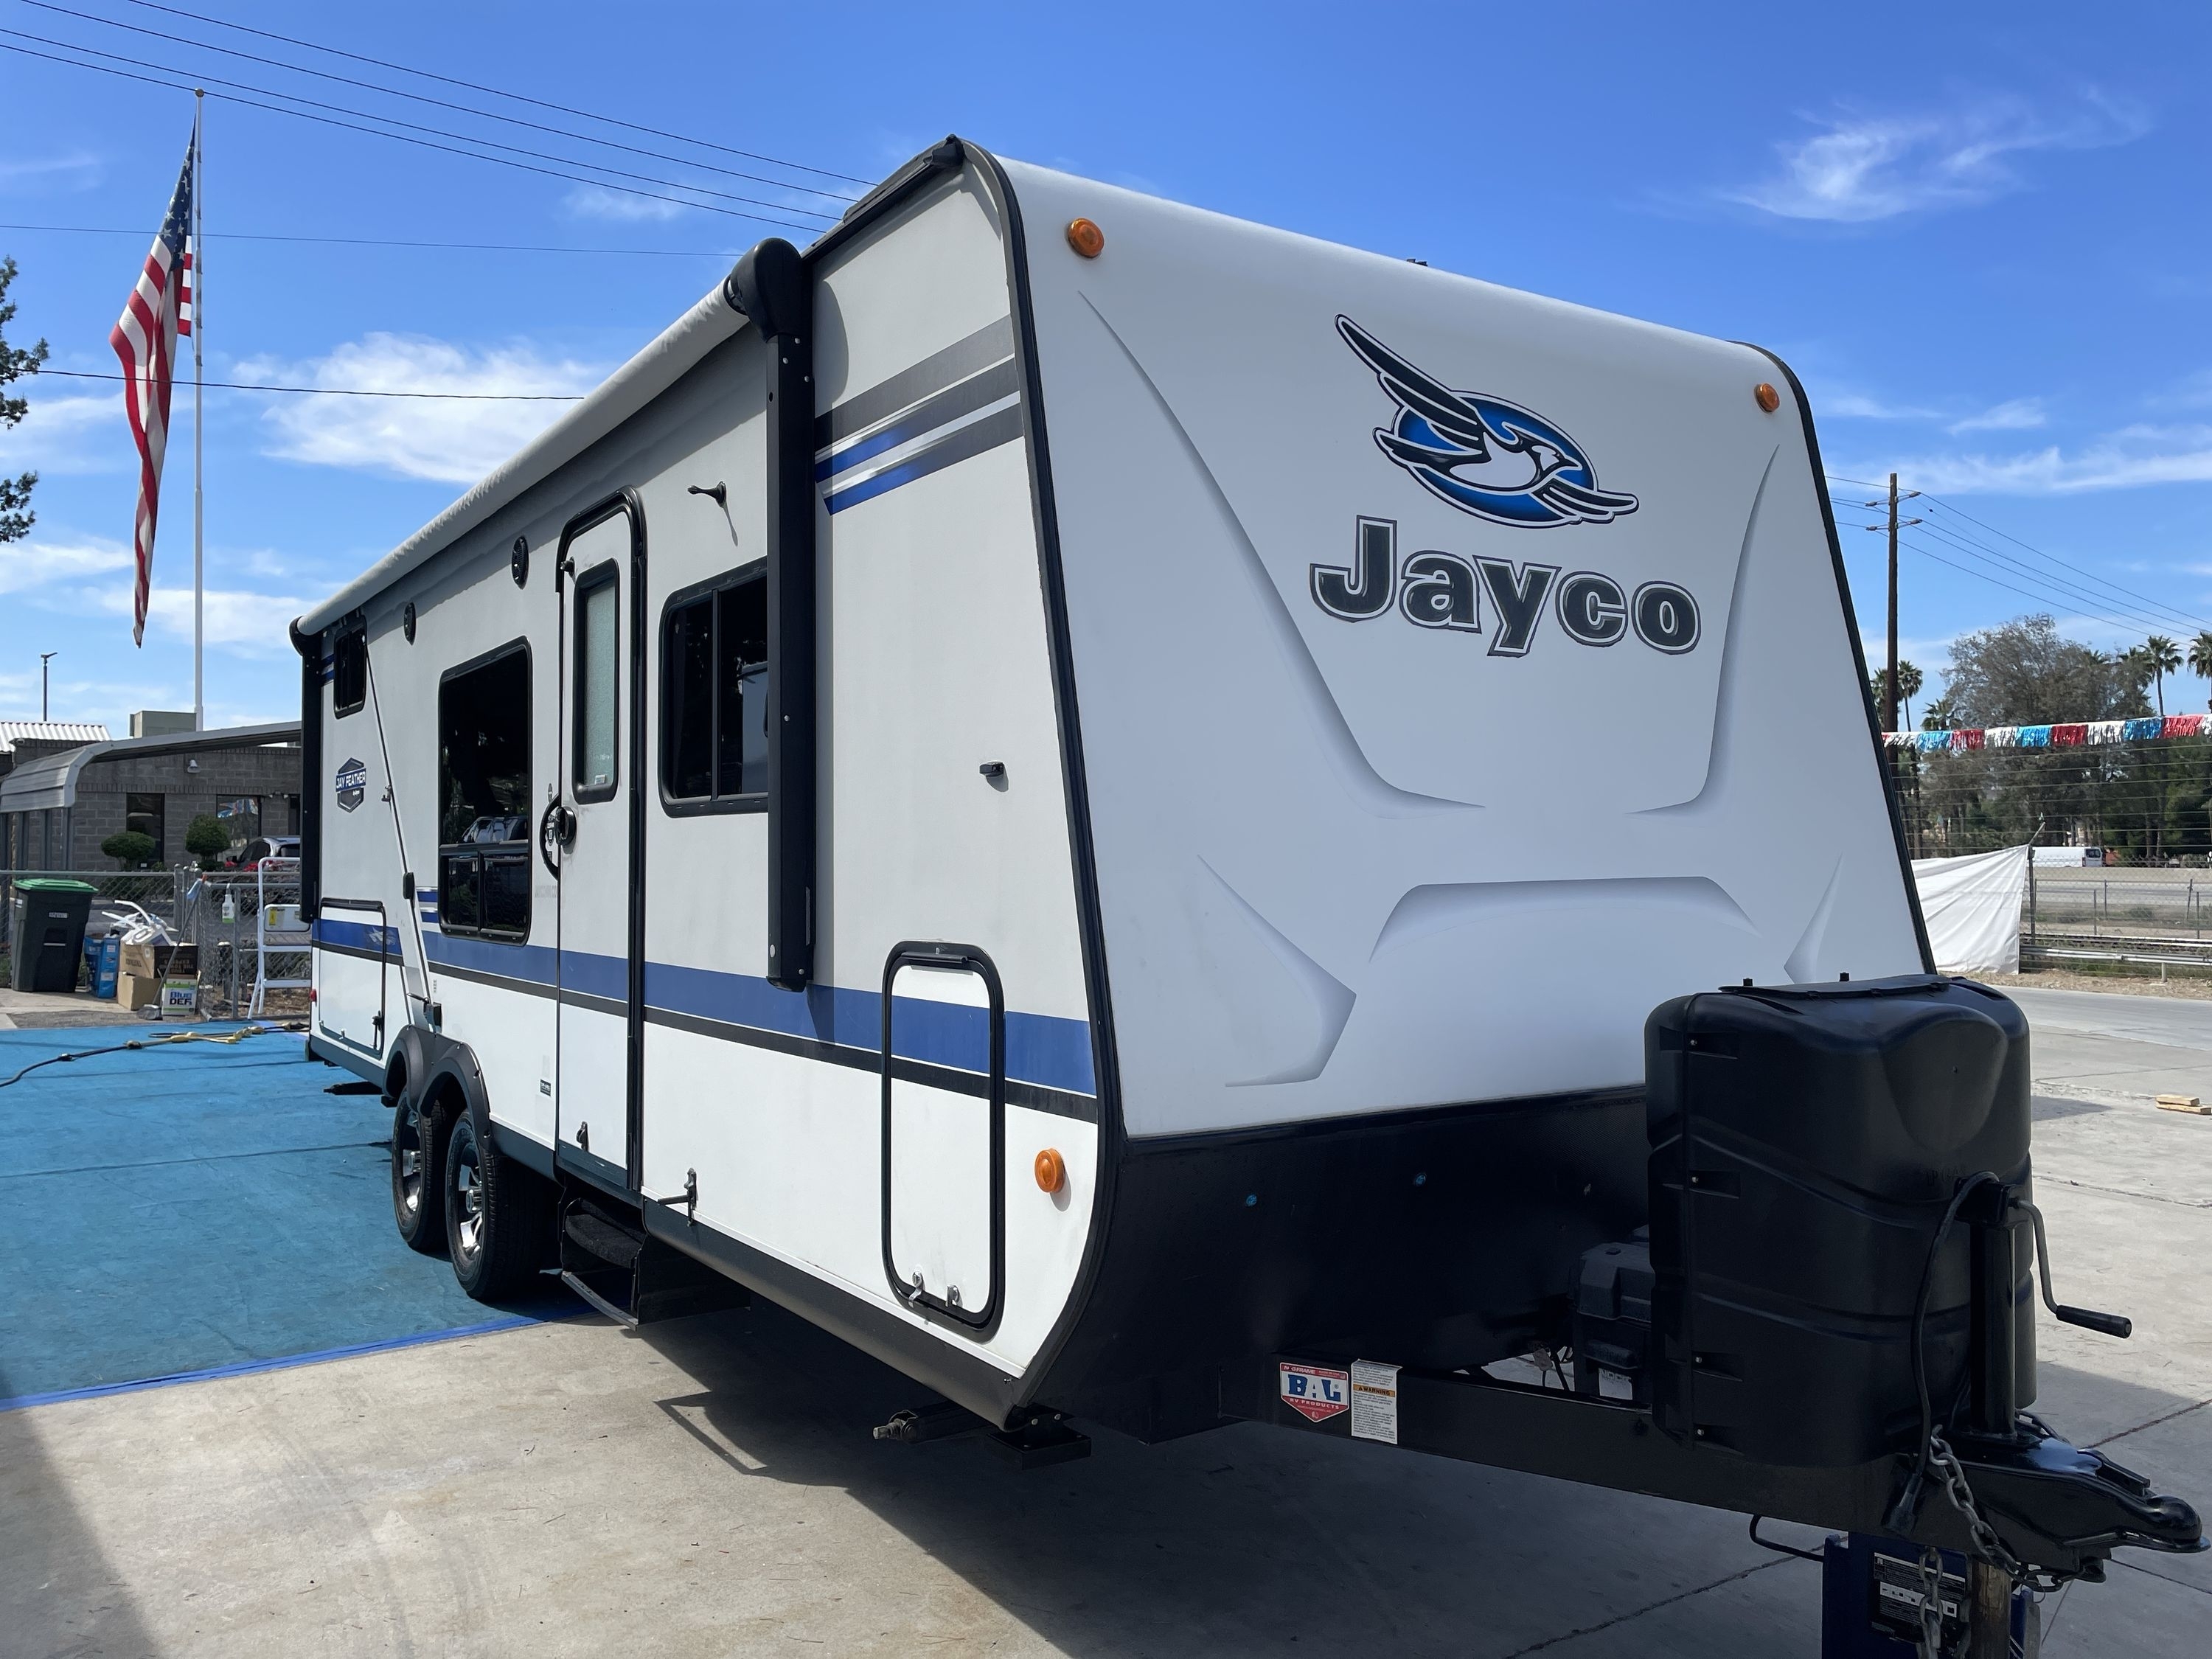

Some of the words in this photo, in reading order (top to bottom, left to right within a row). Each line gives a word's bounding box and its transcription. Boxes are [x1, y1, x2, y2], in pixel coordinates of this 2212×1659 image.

[1309, 515, 1702, 658] Jayco
[336, 776, 345, 789] JAY
[345, 771, 365, 787] FEATHER
[1288, 1374, 1340, 1402] BAL
[1363, 1387, 1390, 1395] WARNING
[1301, 1400, 1339, 1409] PRODUCTS
